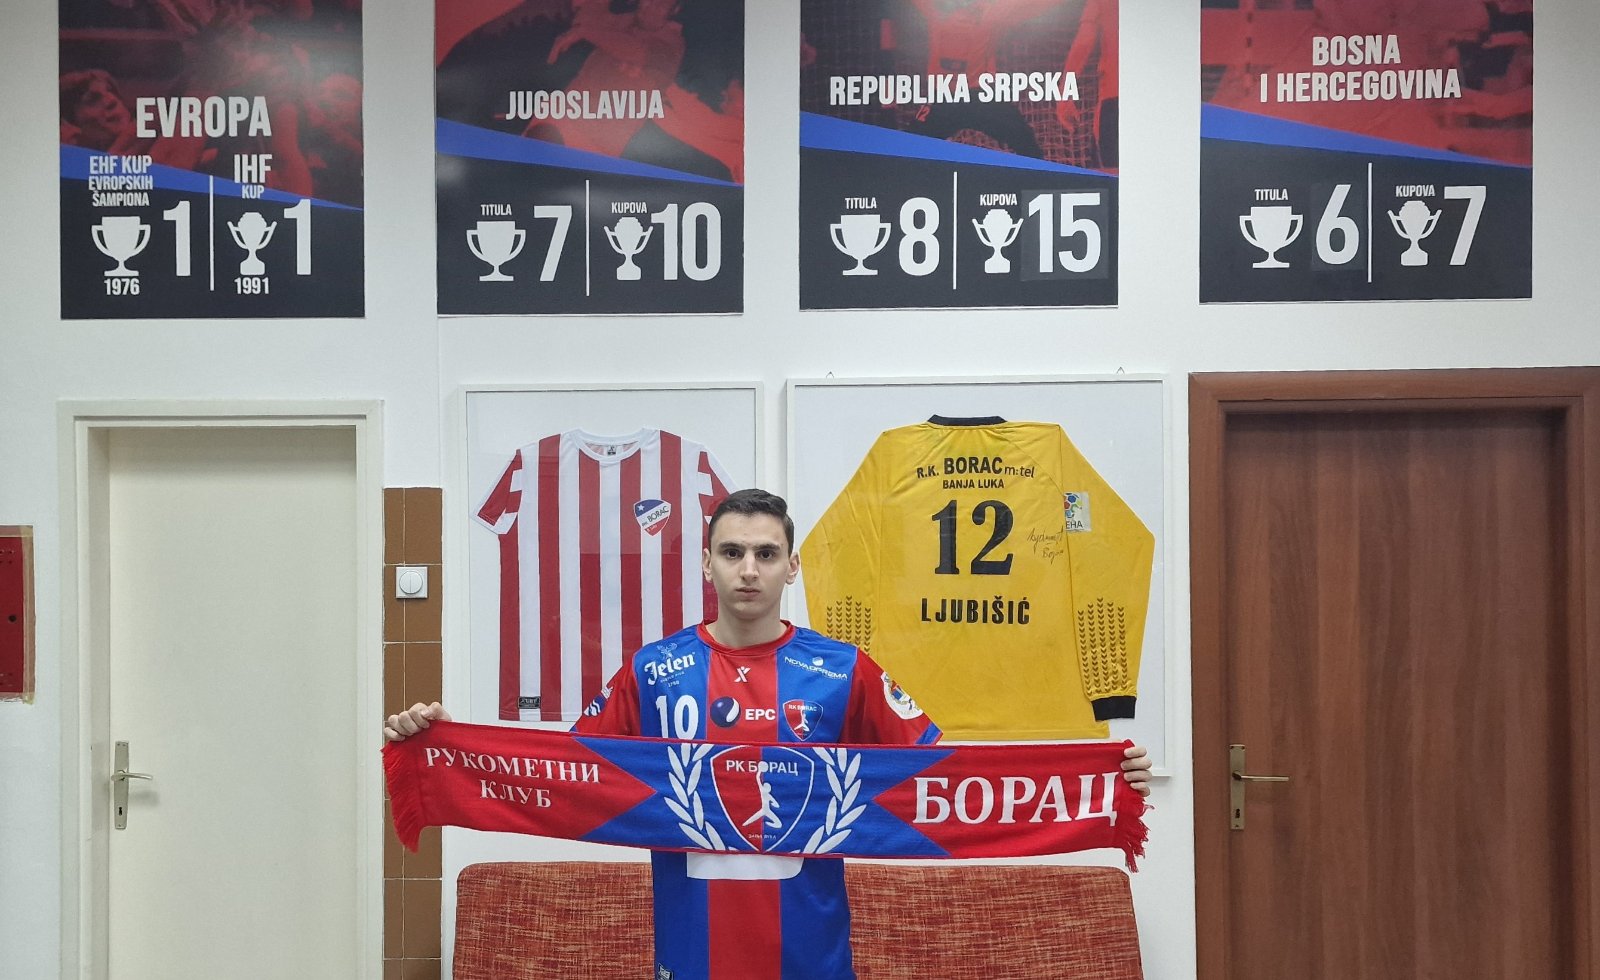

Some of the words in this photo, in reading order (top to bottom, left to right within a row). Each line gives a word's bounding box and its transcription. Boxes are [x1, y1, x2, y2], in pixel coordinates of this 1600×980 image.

[1312, 35, 1401, 66] BOSNA
[830, 73, 971, 106] REPUBLIKA
[978, 72, 1080, 103] SRPSKA
[1260, 74, 1268, 103] I
[1277, 69, 1462, 102] HERCEGOVINA
[136, 96, 272, 138] EVROPA
[506, 90, 665, 120] JUGOSLAVIJA
[90, 156, 117, 175] EHF
[122, 155, 153, 174] KUP
[234, 154, 273, 184] IHF
[88, 175, 153, 191] EVROPSKIH
[241, 185, 265, 199] KUP
[1254, 188, 1289, 201] TITULA
[1395, 184, 1436, 197] KUPOVA
[92, 190, 150, 207] ŠAMPIONA
[481, 204, 512, 216] TITULA
[611, 202, 648, 214] KUPOVA
[845, 197, 877, 209] TITULA
[980, 194, 1018, 206] KUPOVA
[163, 201, 191, 277] 1
[284, 199, 312, 275] 1
[898, 197, 940, 276] 8
[1028, 192, 1101, 273] 15
[1316, 184, 1360, 265] 6
[1444, 185, 1487, 266] 7
[534, 205, 573, 282] 7
[651, 202, 722, 281] 10
[104, 278, 140, 295] 1976
[234, 277, 270, 294] 1991
[916, 465, 940, 478] R.K.
[944, 457, 1003, 475] BORAC
[1004, 466, 1035, 478] m:tel
[943, 479, 975, 489] BANJA
[978, 479, 1004, 489] LUKA
[647, 506, 669, 522] BORAC
[931, 499, 1014, 575] 12
[921, 595, 1030, 625] LJUBIŠIĆ
[644, 653, 696, 686] Jelen
[655, 695, 699, 739] 10
[745, 708, 776, 721] EPC
[424, 747, 601, 783] РУКОМЕТНИ
[480, 779, 552, 808] КЛУБ
[912, 772, 1119, 827] БОРАЦ
